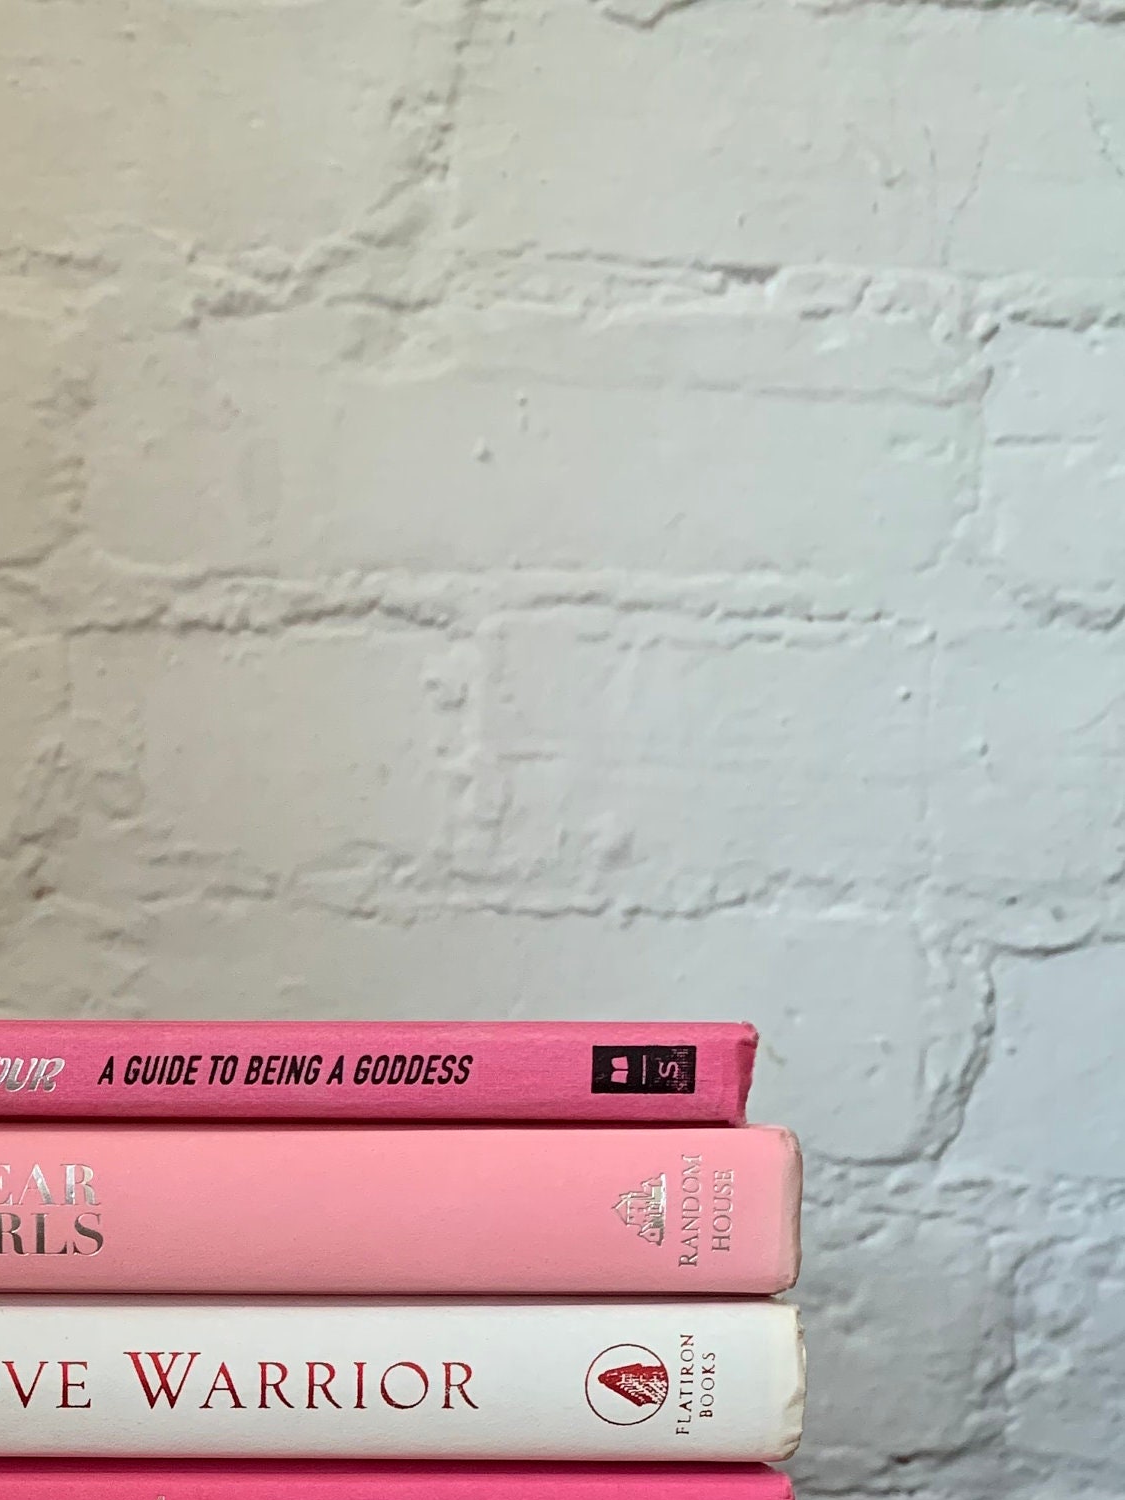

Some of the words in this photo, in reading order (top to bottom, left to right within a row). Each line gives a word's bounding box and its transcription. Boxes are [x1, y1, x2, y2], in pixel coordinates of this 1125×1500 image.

[97, 1055, 115, 1085] A
[123, 1055, 202, 1086] GUIDE
[208, 1055, 239, 1086] TO
[244, 1055, 323, 1086] BEING
[326, 1055, 345, 1086] A
[352, 1054, 474, 1086] GODDESS
[678, 1154, 702, 1267] RANDOM
[711, 1169, 734, 1252] HOUSE
[123, 1352, 479, 1409] WARRIOR
[675, 1334, 695, 1435] FLATIRON
[699, 1352, 716, 1418] BOOKS
